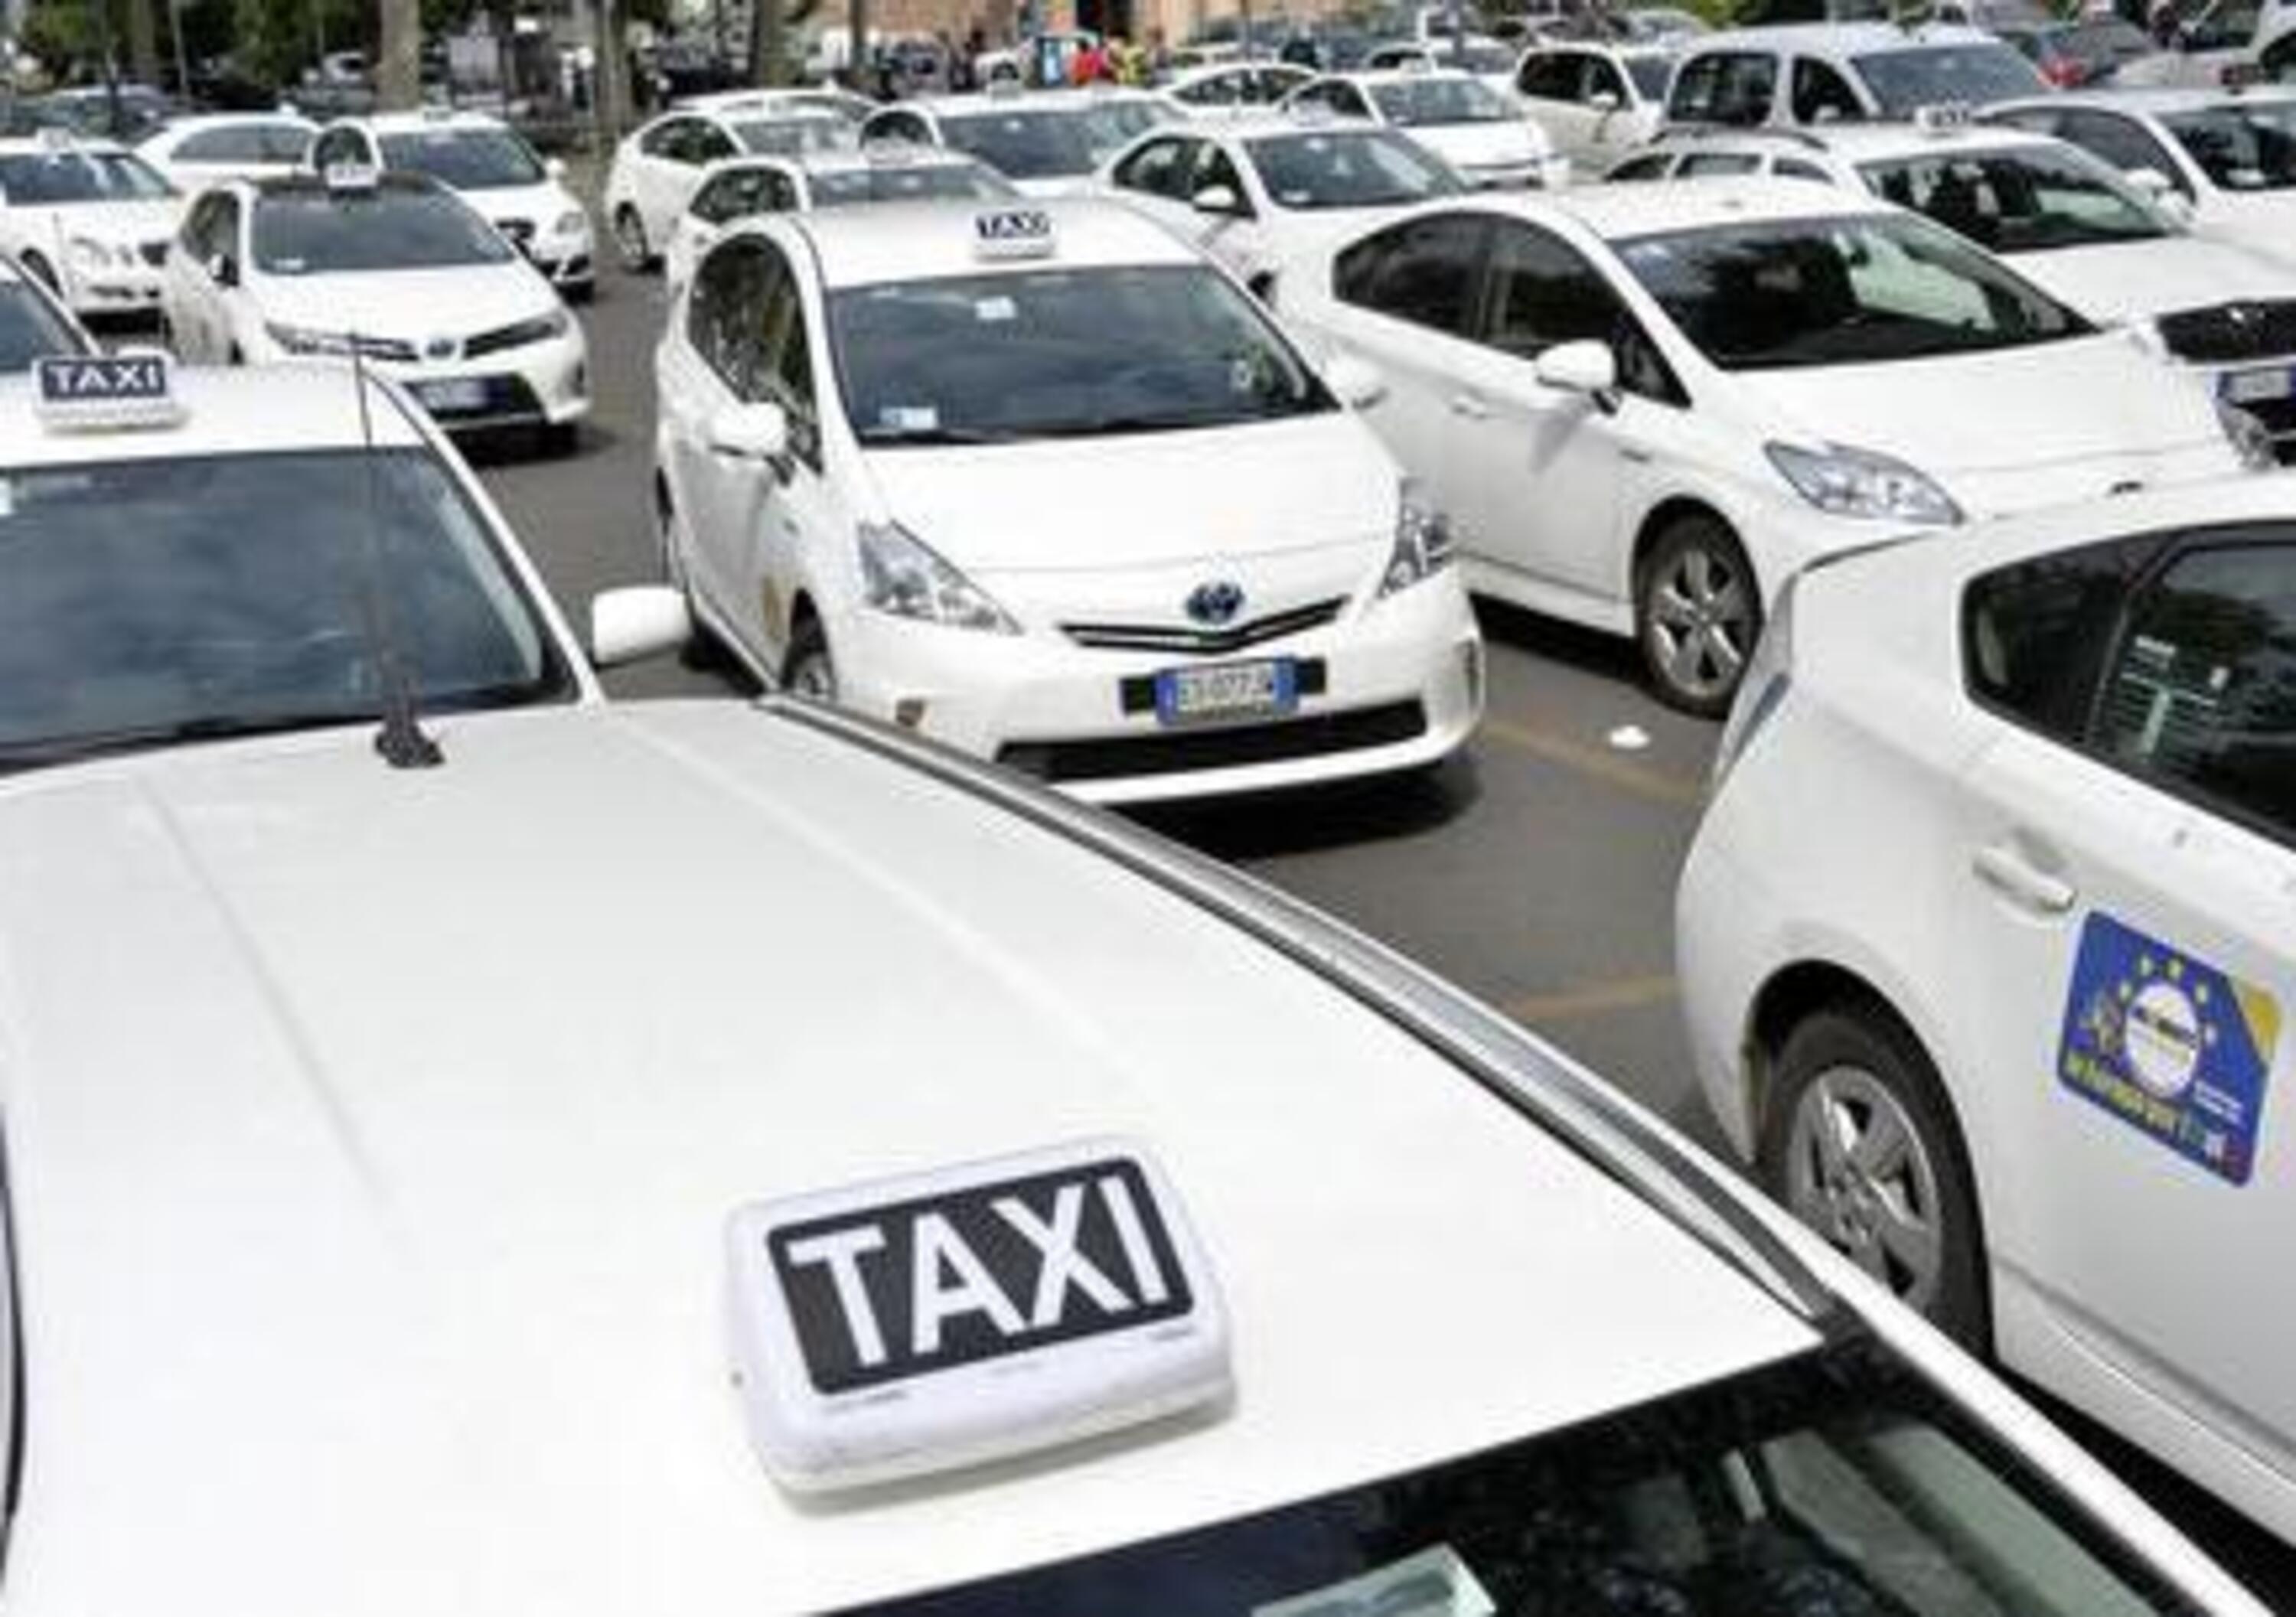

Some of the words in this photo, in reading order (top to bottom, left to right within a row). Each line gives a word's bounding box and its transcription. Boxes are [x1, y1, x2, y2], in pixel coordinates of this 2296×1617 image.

[977, 212, 1050, 238] TAXI
[47, 363, 158, 393] TAXI
[785, 1176, 1168, 1366] TAXI
